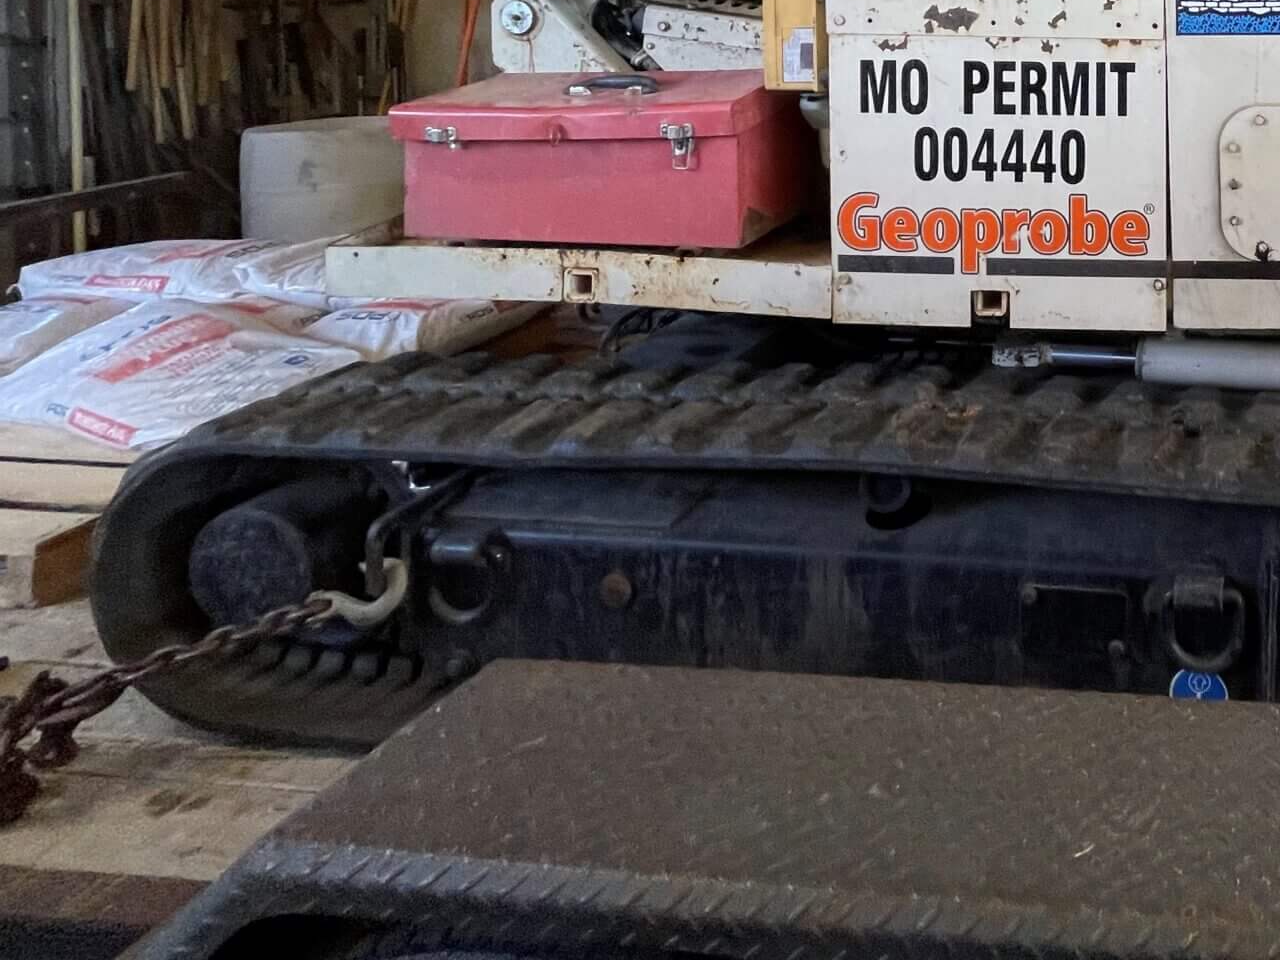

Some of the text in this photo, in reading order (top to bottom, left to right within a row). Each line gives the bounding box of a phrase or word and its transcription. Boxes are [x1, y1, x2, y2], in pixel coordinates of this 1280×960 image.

[860, 59, 1136, 117] MO PERMIT
[914, 126, 1086, 184] 004440
